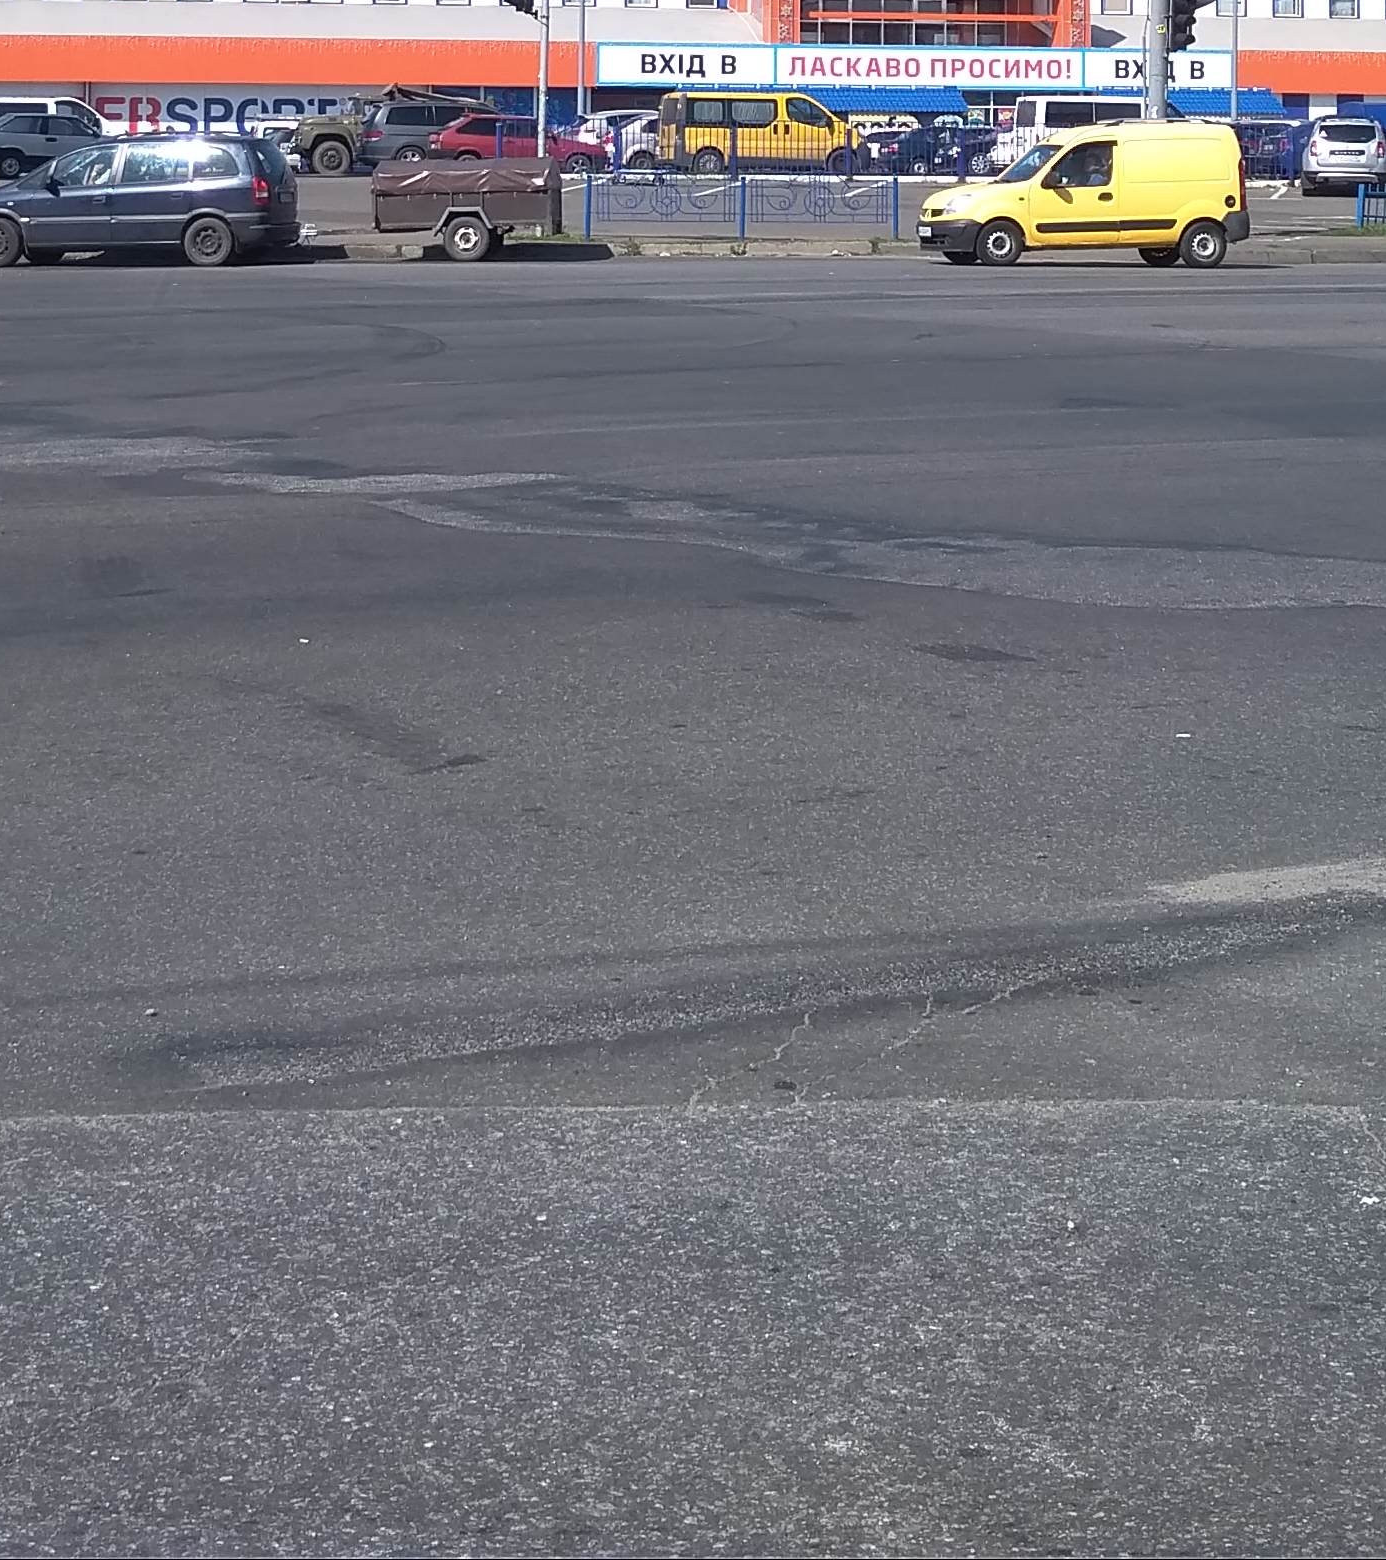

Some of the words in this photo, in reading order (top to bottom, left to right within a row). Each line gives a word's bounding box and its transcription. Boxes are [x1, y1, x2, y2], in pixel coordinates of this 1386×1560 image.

[639, 52, 707, 79] ВХІД
[719, 54, 738, 77] В
[787, 54, 922, 81] ЛАСКАВО
[929, 55, 1073, 83] ПРОСИМО!
[1114, 58, 1177, 83] ВХД
[1190, 60, 1205, 80] В
